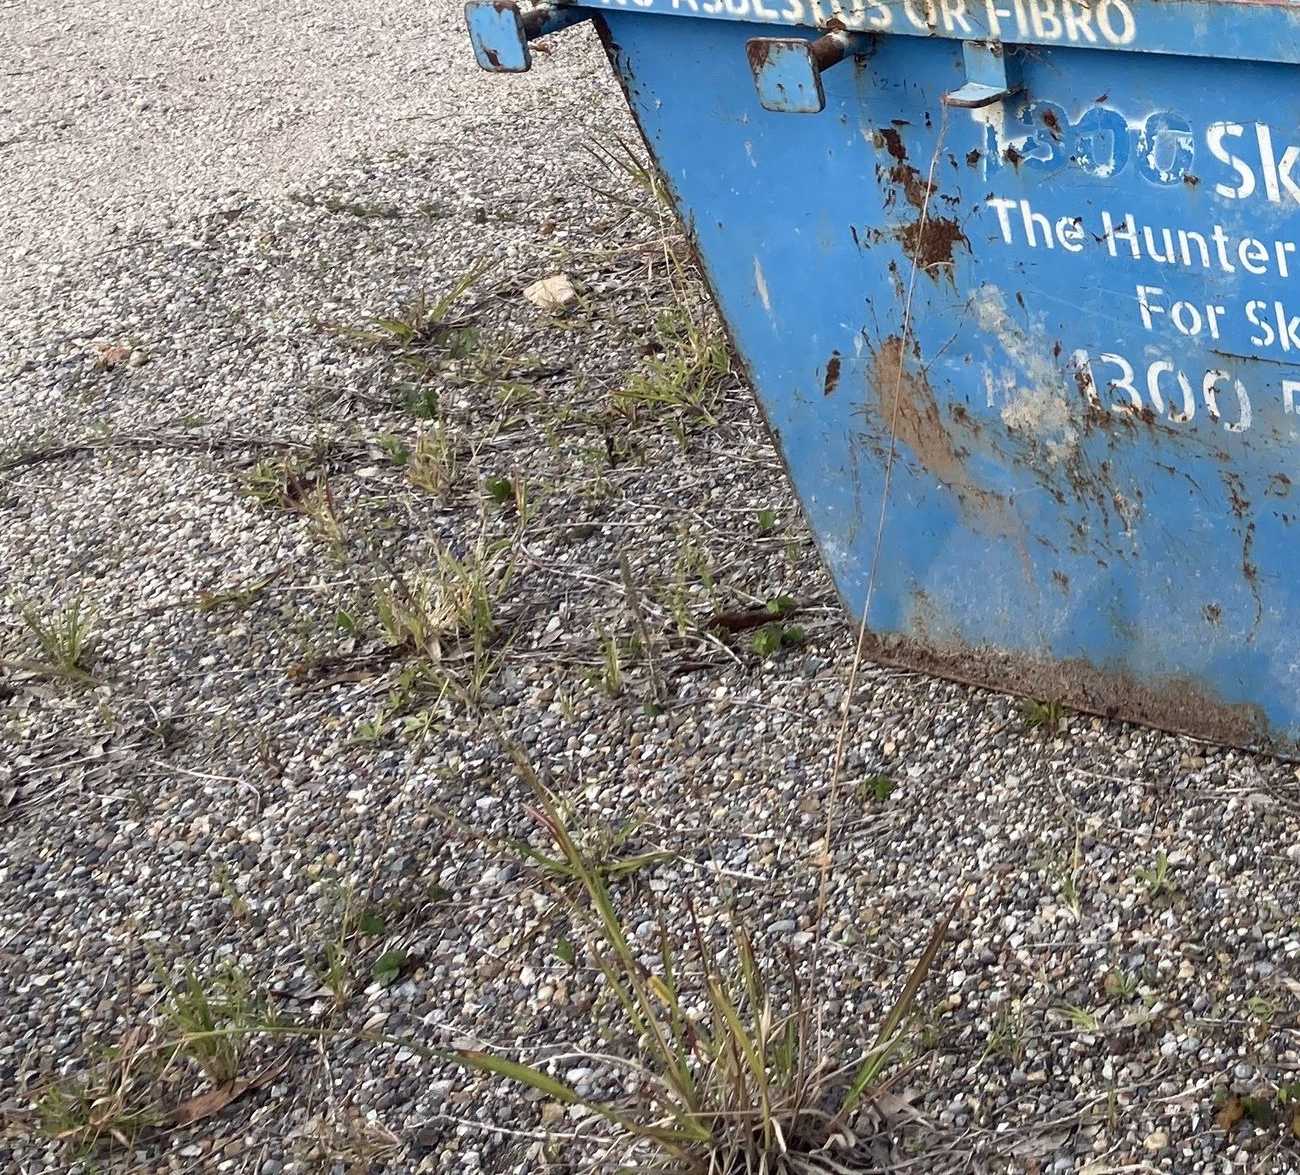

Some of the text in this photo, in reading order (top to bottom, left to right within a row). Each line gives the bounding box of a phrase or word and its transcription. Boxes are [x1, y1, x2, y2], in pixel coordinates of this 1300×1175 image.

[988, 198, 1086, 253] The
[1101, 210, 1296, 279] Hunter
[1137, 284, 1226, 339] For
[1073, 348, 1252, 433] 1300
